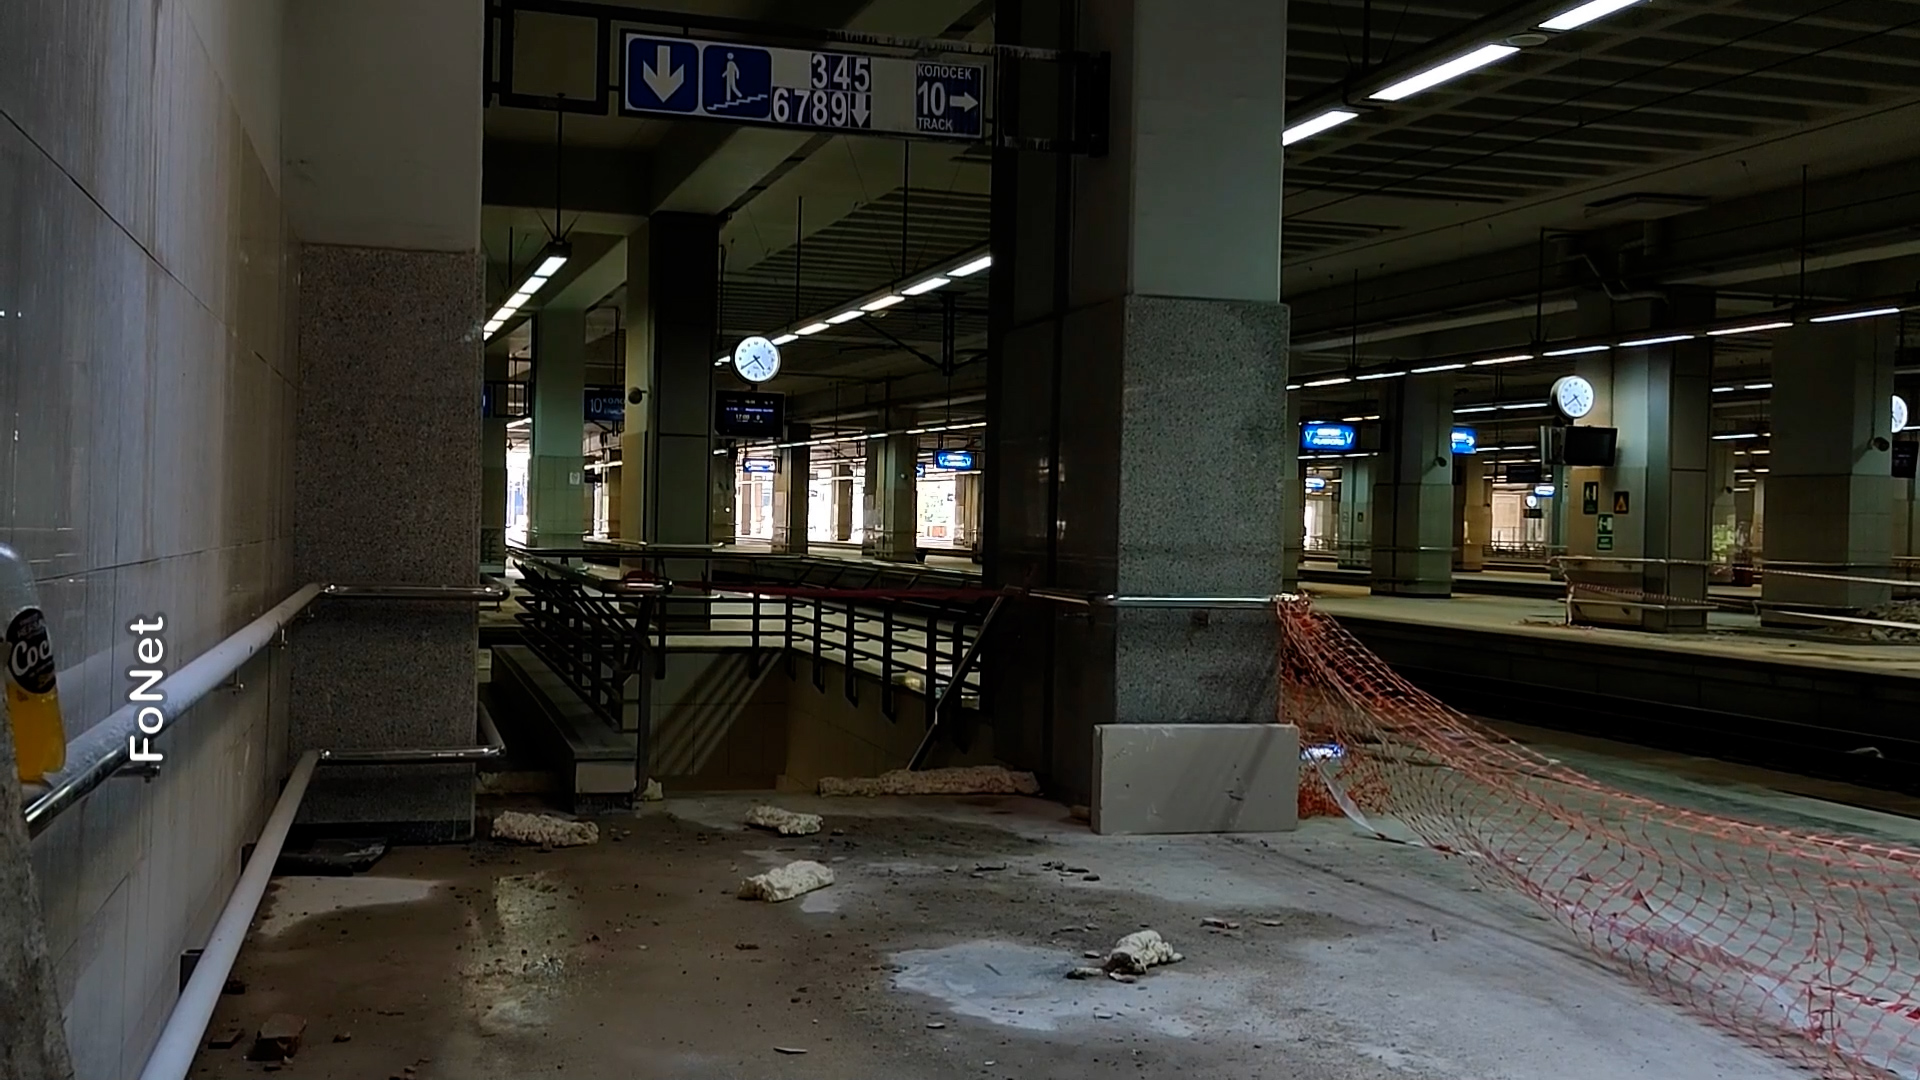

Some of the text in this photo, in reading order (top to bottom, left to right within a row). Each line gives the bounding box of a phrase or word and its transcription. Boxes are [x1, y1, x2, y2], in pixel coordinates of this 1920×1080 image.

[918, 65, 972, 81] КОЛОСЕК
[918, 81, 946, 116] 10
[917, 117, 953, 131] TRACK
[590, 398, 602, 414] 10
